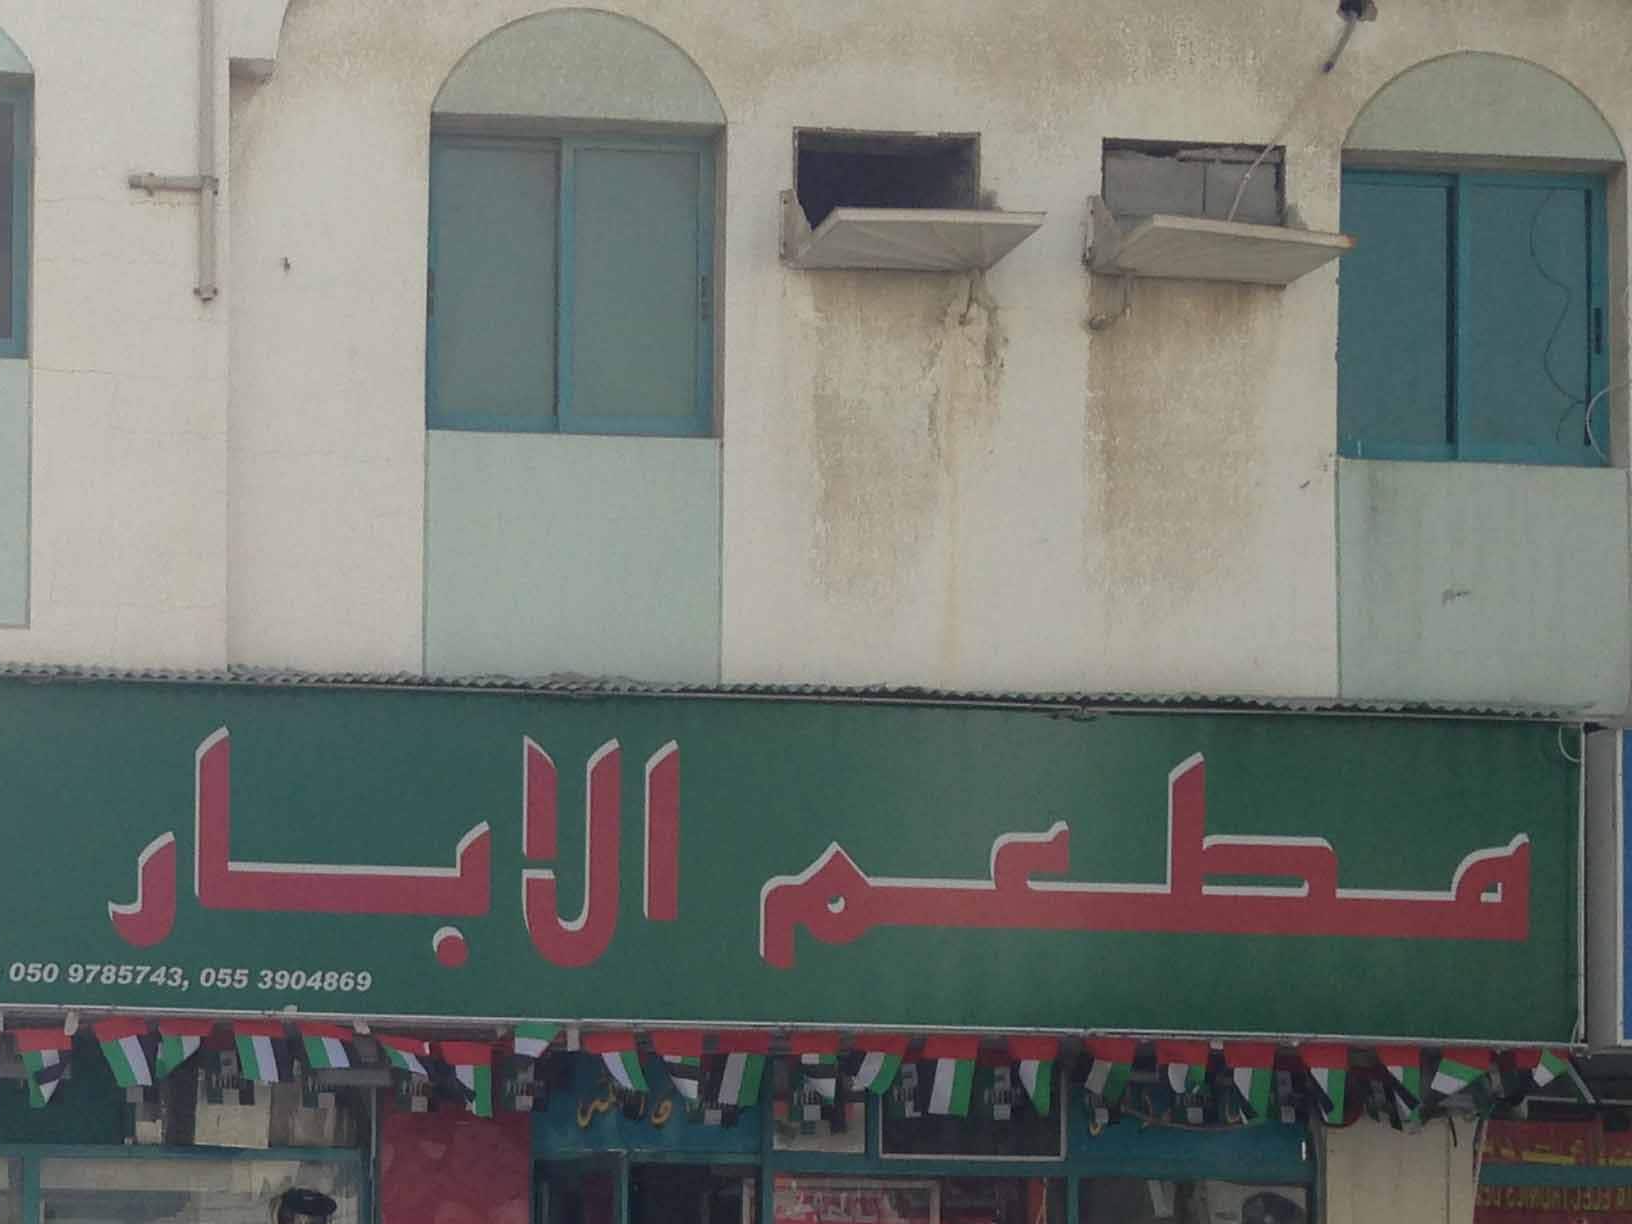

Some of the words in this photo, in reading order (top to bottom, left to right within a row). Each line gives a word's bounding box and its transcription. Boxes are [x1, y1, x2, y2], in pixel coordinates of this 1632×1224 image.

[759, 750, 1530, 970] مطعم
[9, 962, 59, 984] 050
[67, 963, 190, 991] 9785743,
[199, 967, 249, 989] 055
[257, 968, 373, 993] 3904869
